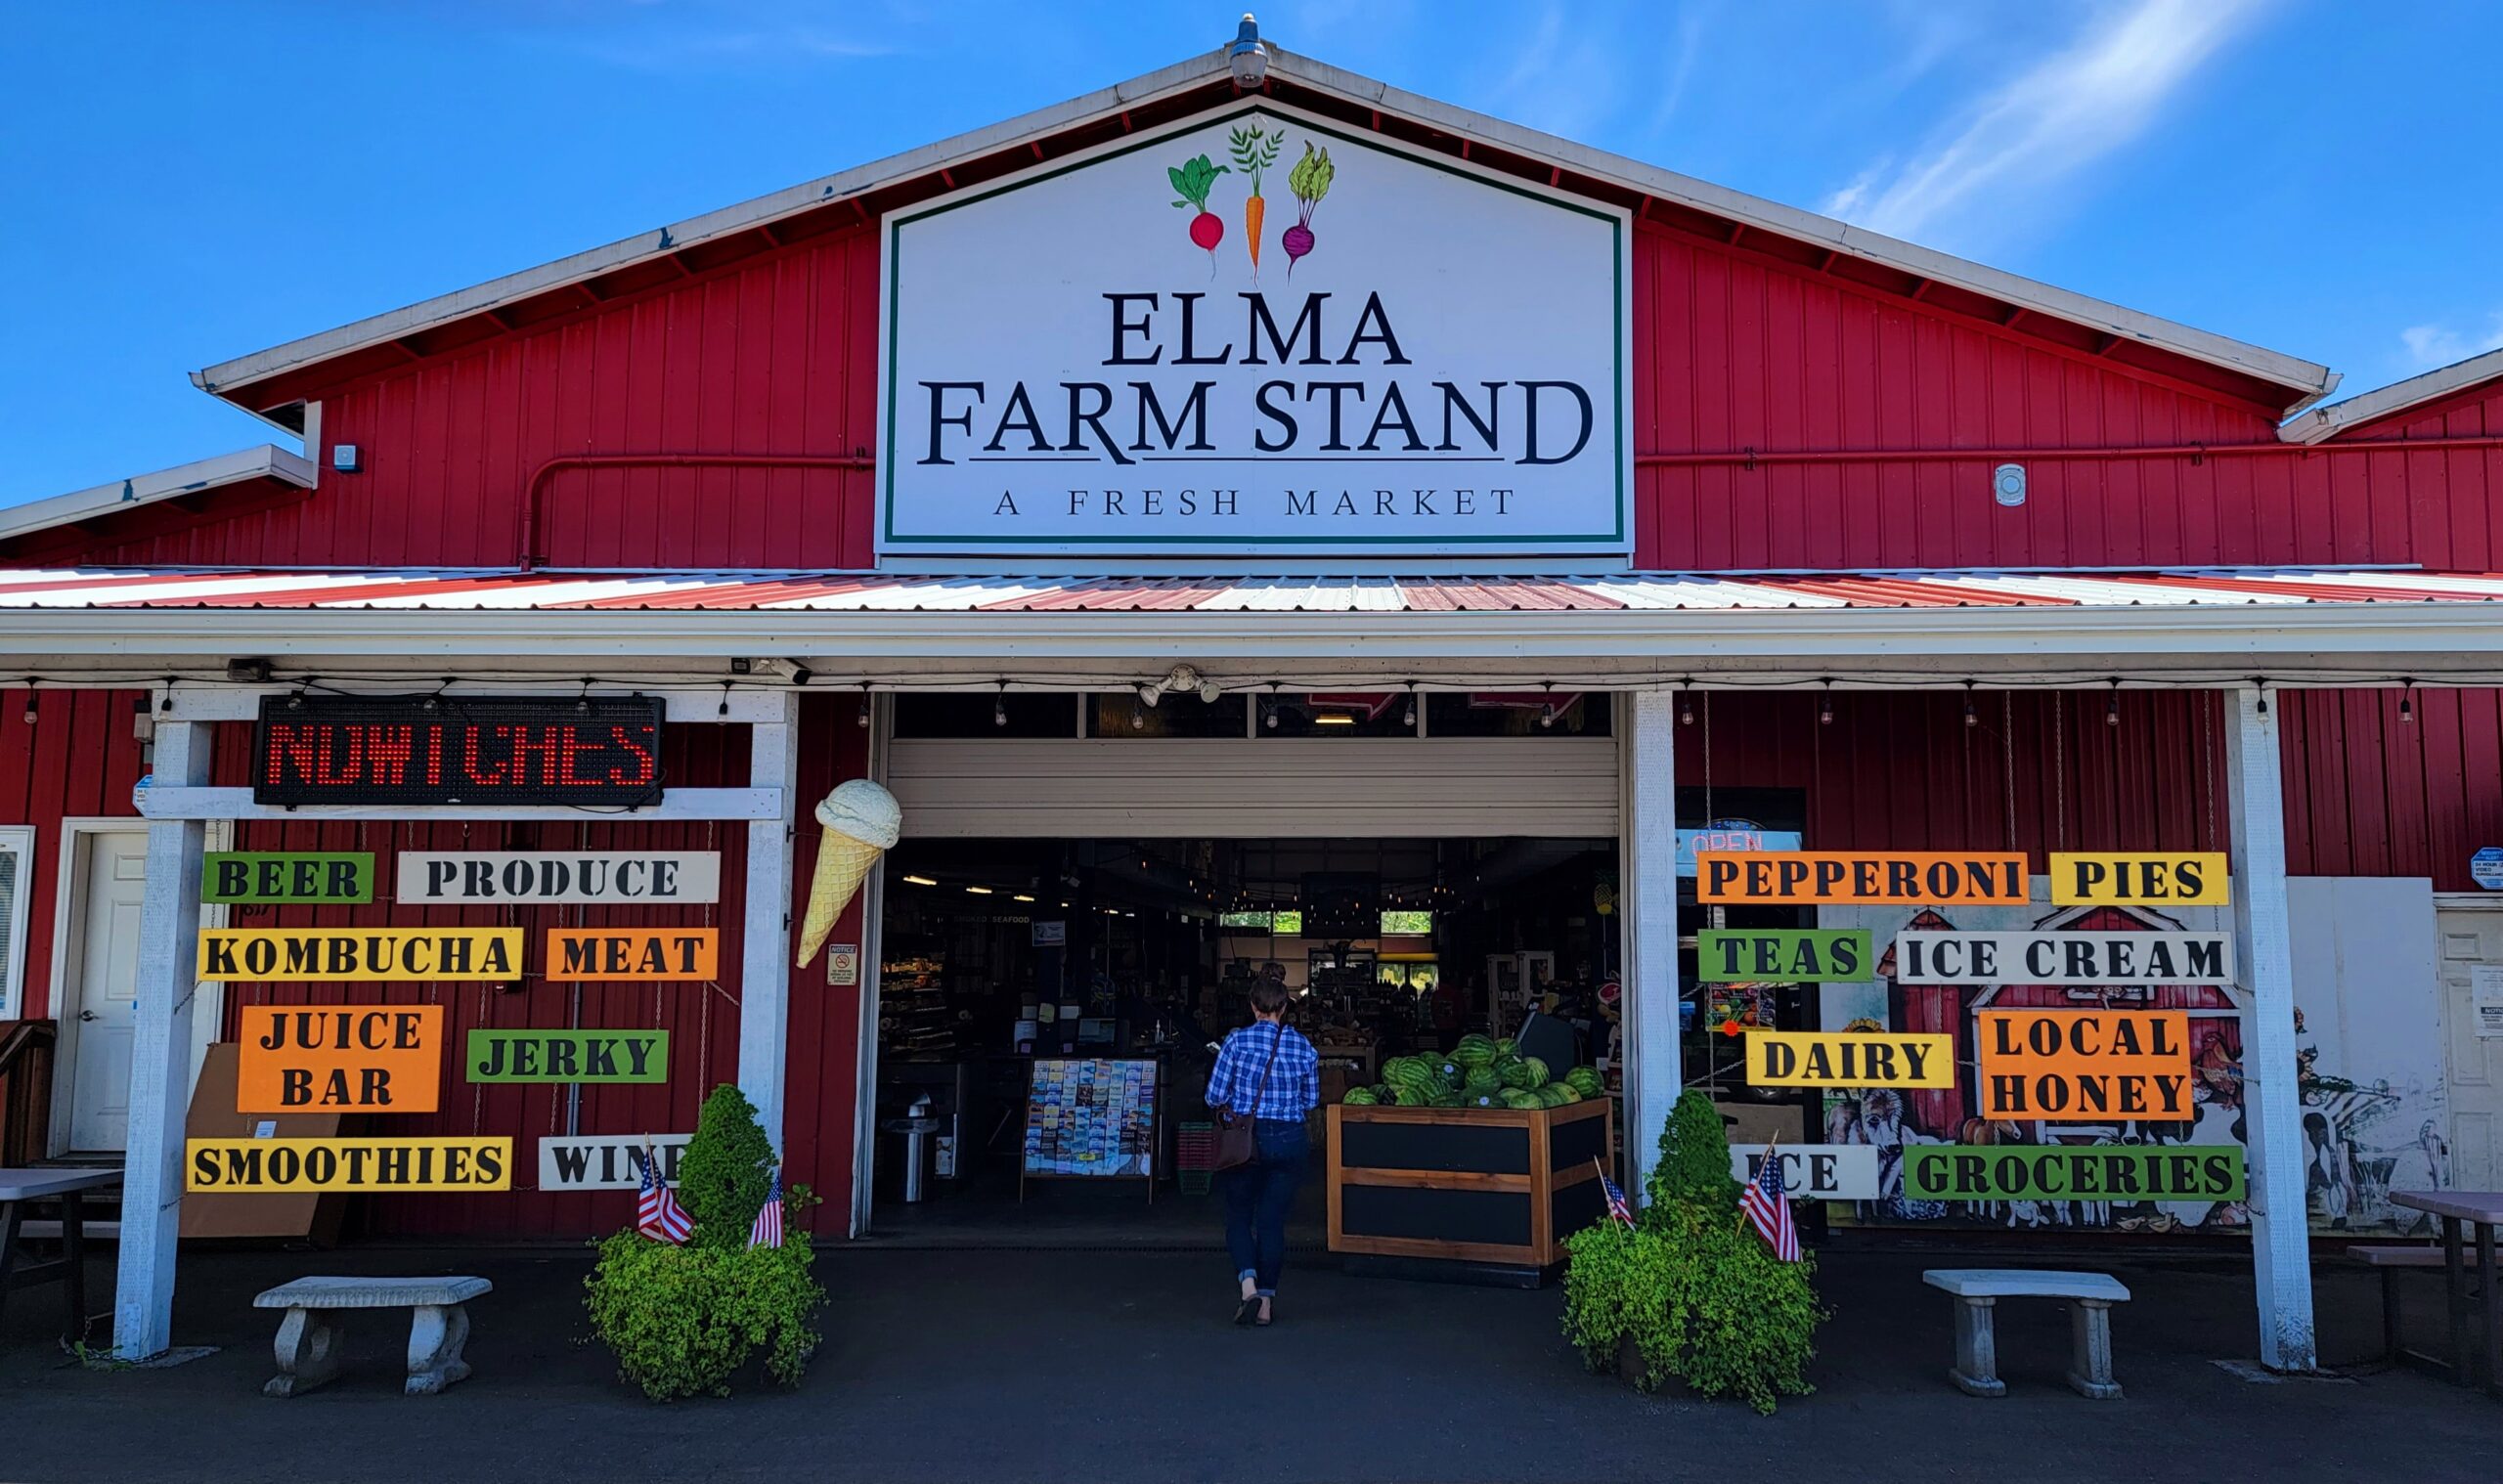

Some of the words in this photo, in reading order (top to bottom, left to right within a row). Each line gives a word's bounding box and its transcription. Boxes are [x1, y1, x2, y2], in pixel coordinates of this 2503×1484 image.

[1102, 291, 1412, 365] ELMA
[917, 382, 1216, 464] FARM
[1254, 380, 1592, 464] STAND
[994, 491, 1019, 514] A
[1069, 490, 1238, 515] FRESH
[1286, 490, 1513, 514] MARKET
[216, 860, 360, 897] BEER
[426, 860, 679, 896] PRODUCE
[1708, 860, 2022, 898] PEPPERONI
[2075, 861, 2203, 898] PIES
[205, 938, 510, 975] KOMBUCHA
[561, 938, 703, 974] MEAT
[1716, 938, 1858, 975] TEAS
[1907, 940, 1998, 978] ICE
[2026, 940, 2224, 978] CREAM
[260, 1012, 421, 1050] JUICE
[1995, 1018, 2178, 1056] LOCAL
[479, 1039, 656, 1075] JERKY
[1764, 1042, 1932, 1080] DAIRY
[281, 1069, 392, 1106] BAR
[1991, 1074, 2185, 1113] HONEY
[196, 1147, 502, 1185] SMOOTHIES
[1917, 1155, 2232, 1195] GROCERIES
